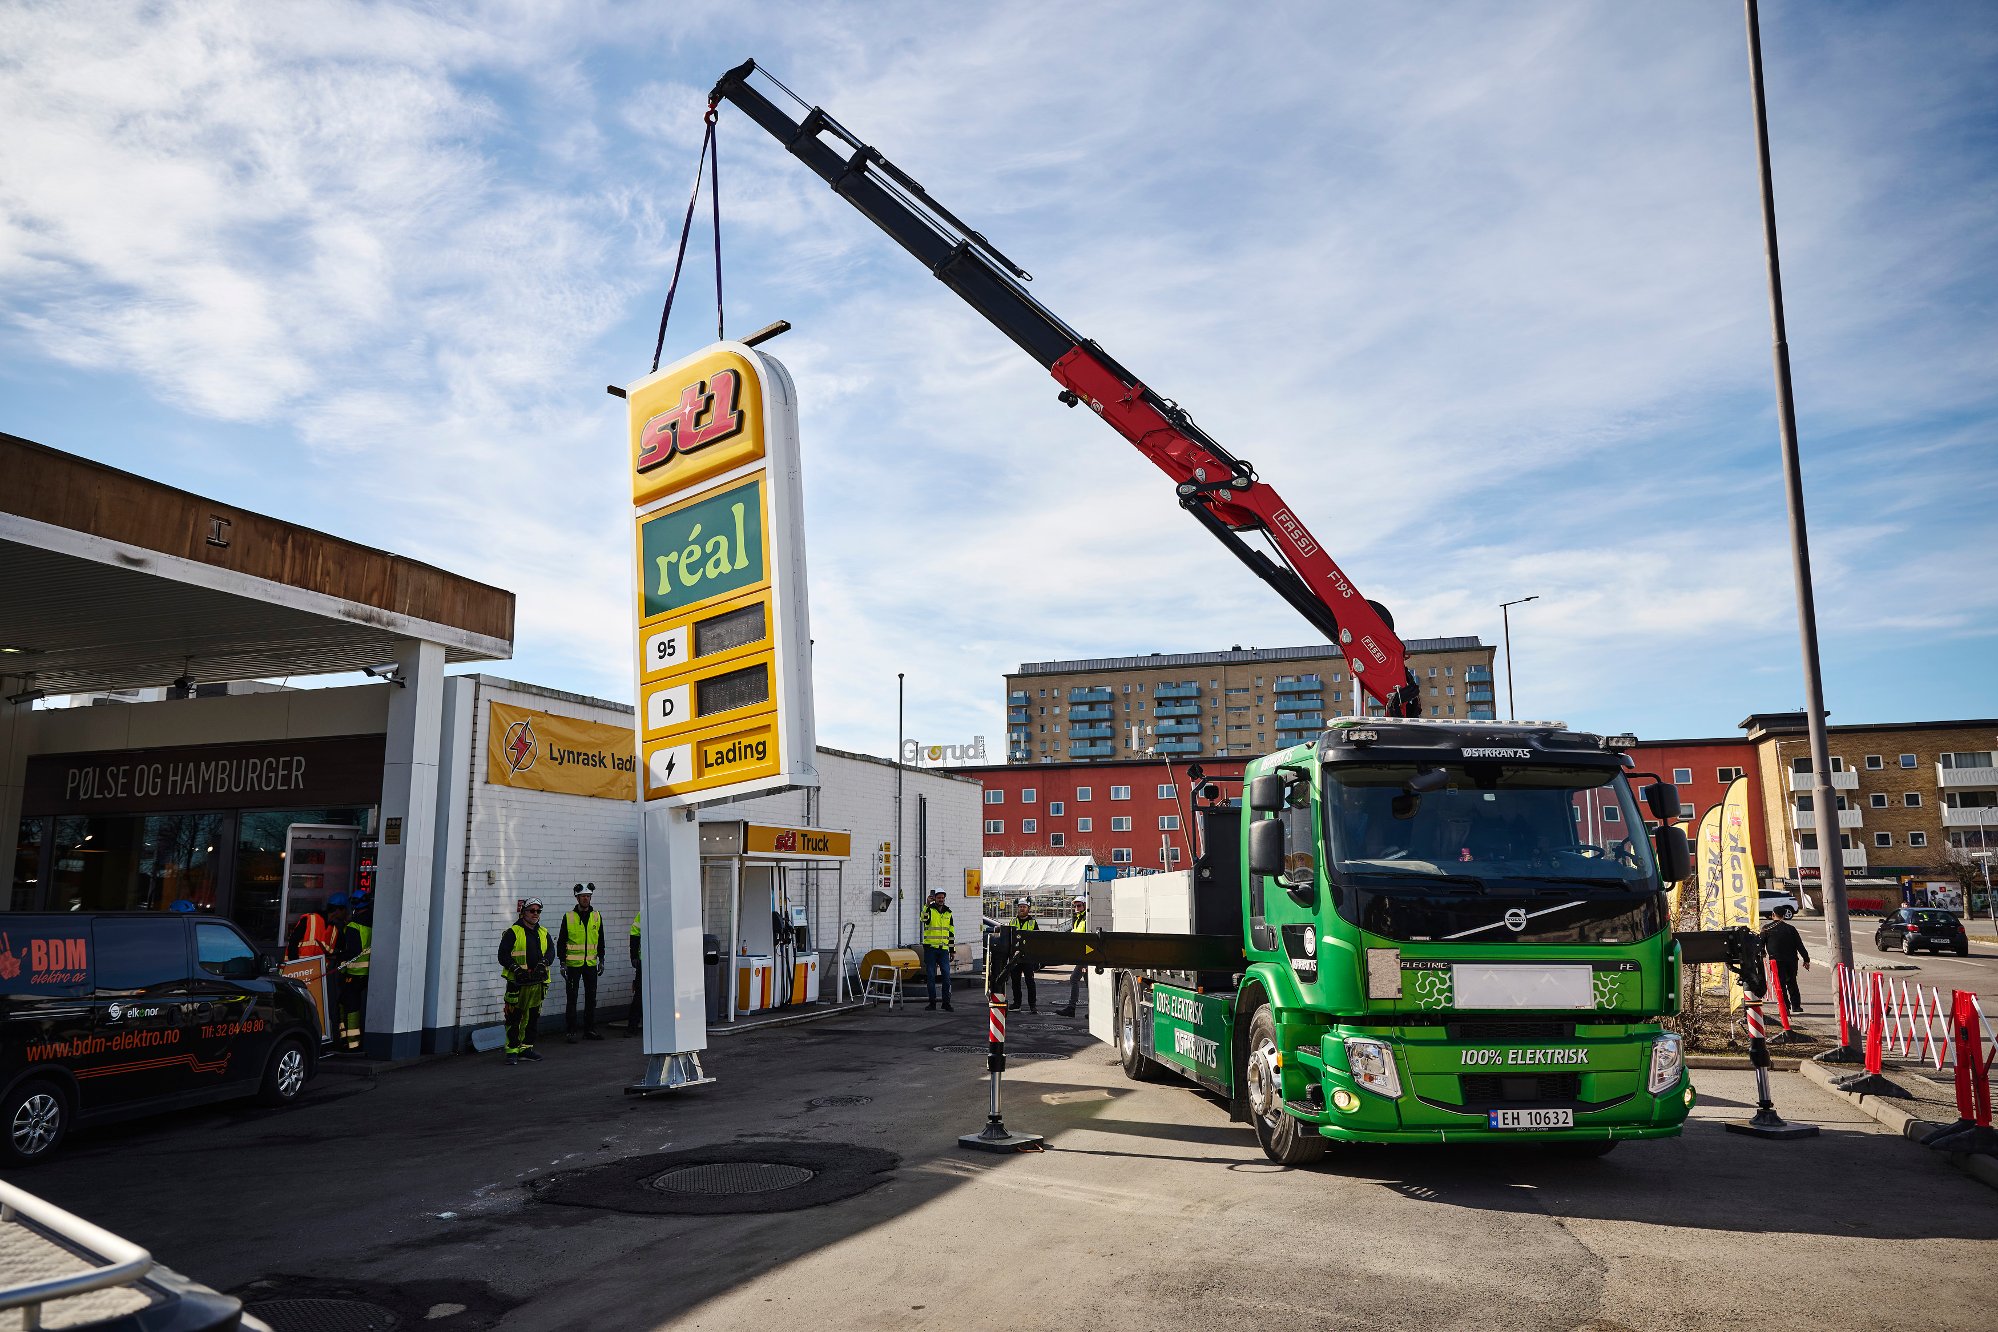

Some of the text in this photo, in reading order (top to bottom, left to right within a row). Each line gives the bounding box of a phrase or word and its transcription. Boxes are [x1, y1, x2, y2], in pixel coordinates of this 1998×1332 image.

[636, 367, 744, 474] st1
[1277, 512, 1315, 554] FASSI
[656, 502, 750, 595] réal
[1326, 570, 1354, 599] F195
[657, 639, 676, 659] 95
[1363, 638, 1385, 662] FASSI
[661, 698, 674, 717] D
[548, 742, 607, 769] Lynrask
[703, 734, 768, 768] Lading
[903, 736, 978, 762] Grorud
[1461, 747, 1532, 759] ØSTKRAN AS
[66, 755, 306, 801] PØLSE OG HAMBURGER
[801, 834, 829, 854] Truck
[31, 938, 87, 973] BDM
[1401, 961, 1448, 969] ELECTRIC
[1619, 963, 1633, 971] FE
[30, 970, 86, 986] elektro as
[1171, 996, 1204, 1026] ELEKTRISK
[201, 1019, 265, 1040] Tlf: 32 84 49 80
[26, 1027, 180, 1063] www.bdm-elektro.no
[1461, 1048, 1589, 1065] 100% ELEKTRISK
[1502, 1111, 1569, 1126] EH 10632
